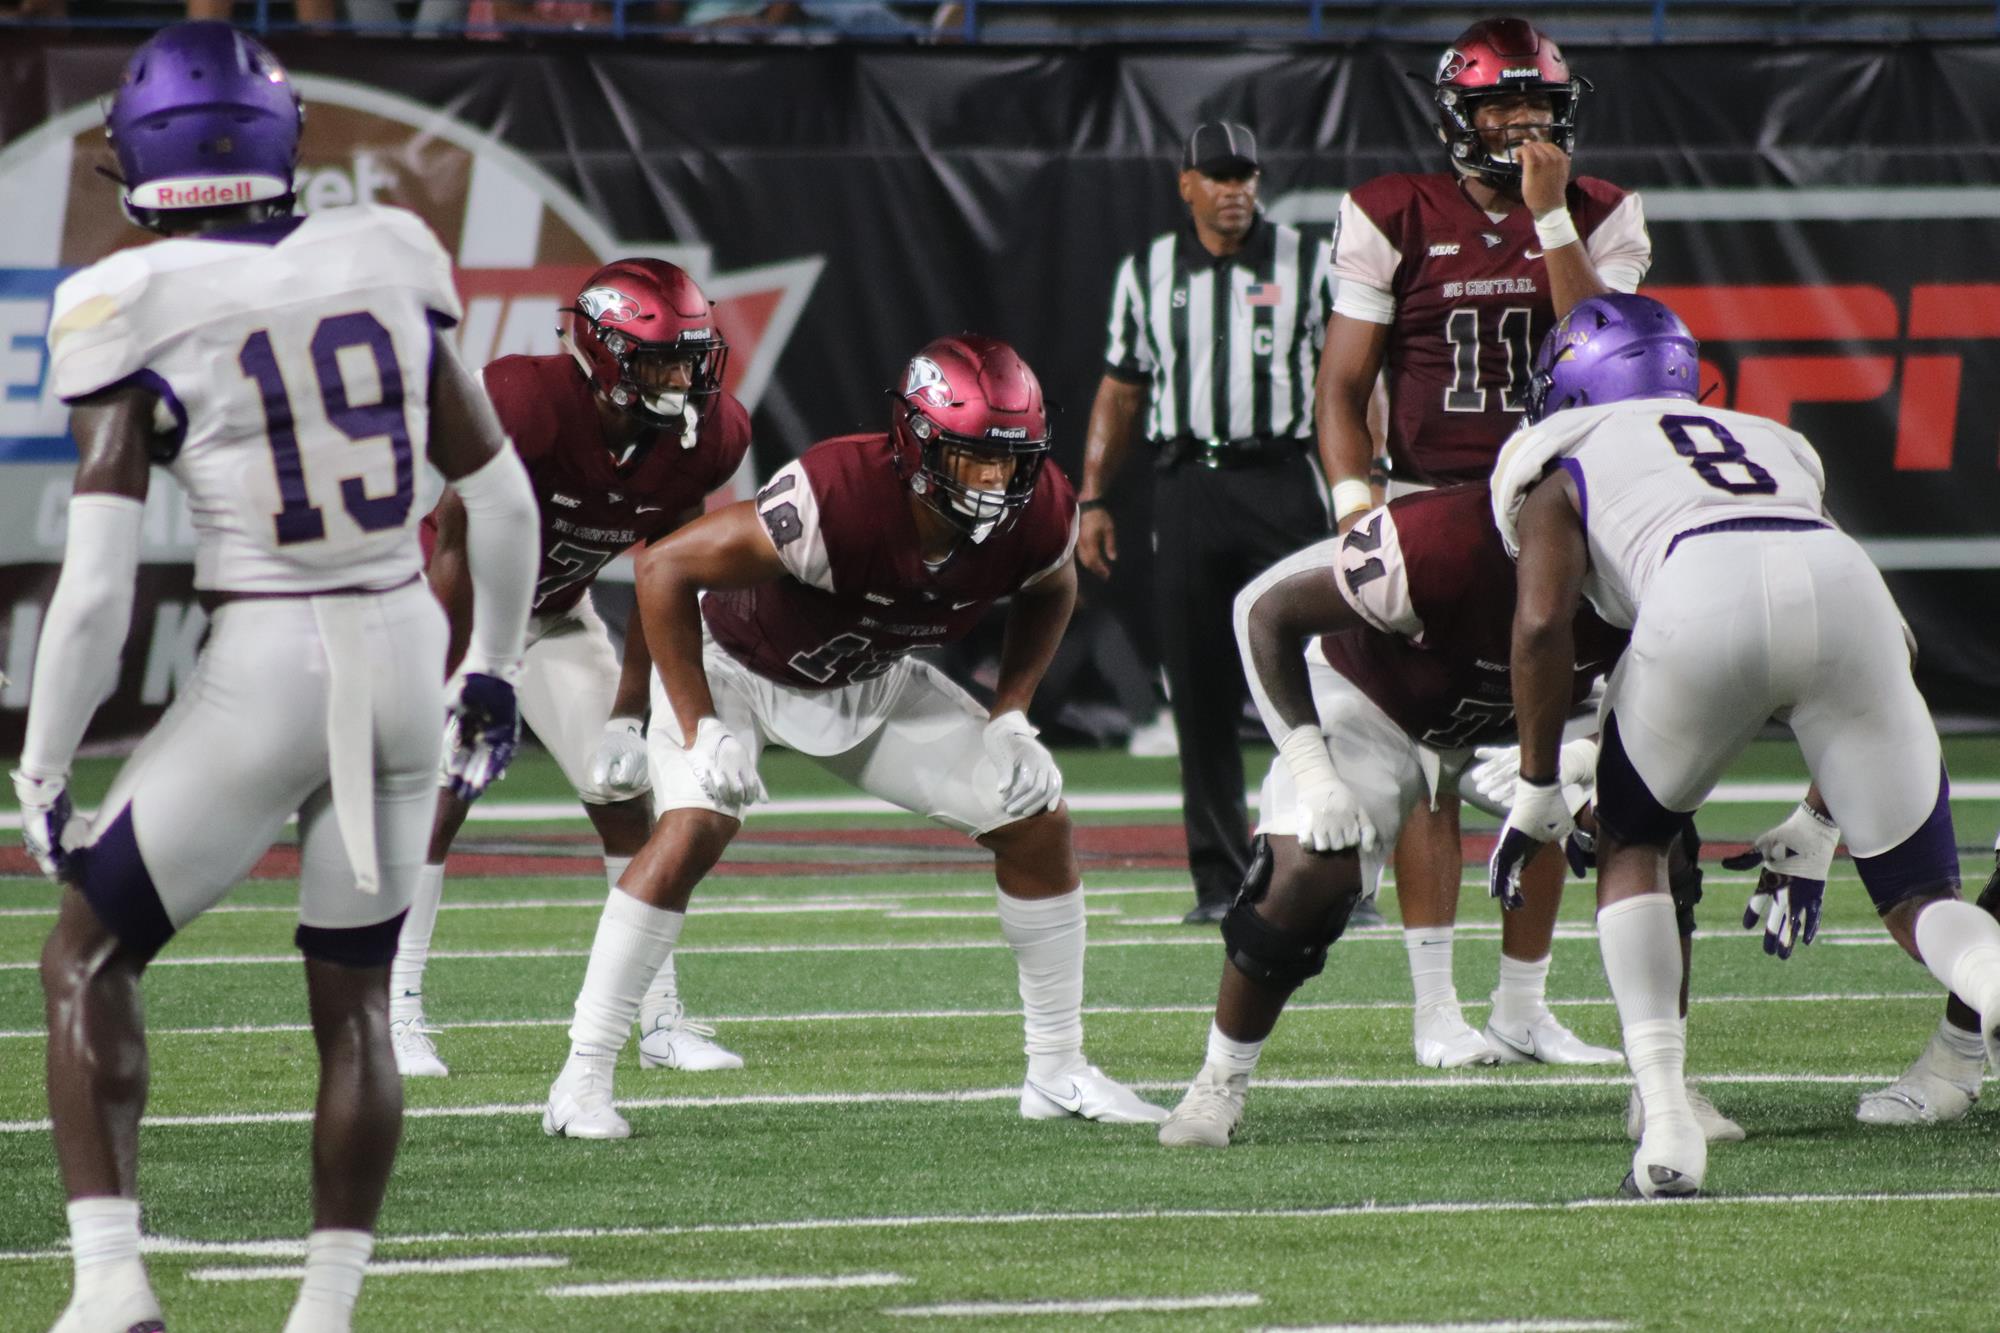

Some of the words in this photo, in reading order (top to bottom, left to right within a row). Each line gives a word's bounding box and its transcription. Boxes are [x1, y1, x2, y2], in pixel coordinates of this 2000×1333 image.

[1503, 69, 1539, 78] Riddell
[157, 182, 252, 206] Riddell
[1429, 245, 1460, 257] MEAC
[1172, 289, 1187, 308] S
[1443, 283, 1463, 298] NC
[1465, 279, 1536, 296] CENTRAL
[1253, 328, 1273, 356] C
[1444, 308, 1532, 412] 11
[238, 310, 415, 546] 19
[991, 428, 1026, 439] Riddell
[1658, 413, 1778, 496] 8
[1342, 513, 1387, 596] 71
[532, 540, 611, 609] 7
